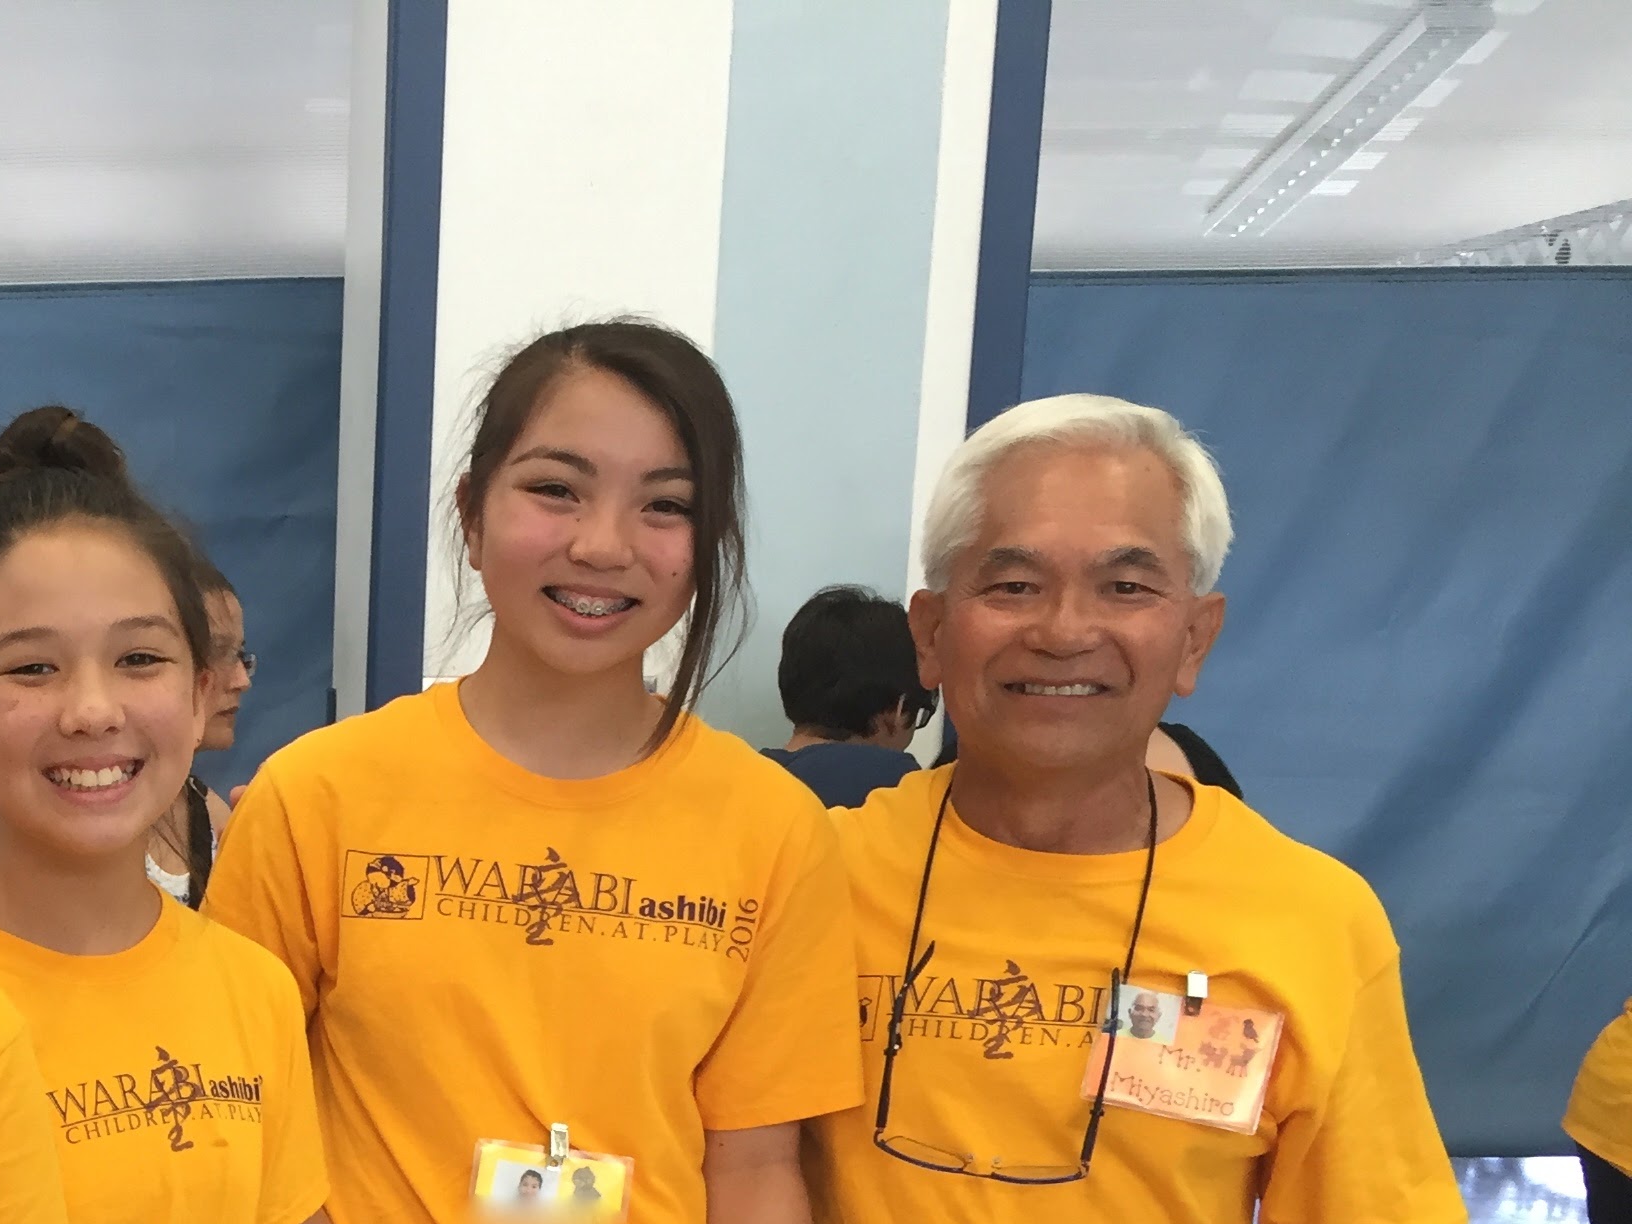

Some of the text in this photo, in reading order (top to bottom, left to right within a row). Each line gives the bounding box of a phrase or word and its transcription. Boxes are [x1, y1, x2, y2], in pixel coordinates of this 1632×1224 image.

[431, 856, 727, 928] WARABI ashibi
[726, 897, 758, 962] 2016
[885, 975, 1106, 1024] WARABI
[1158, 1045, 1201, 1072] Mr.
[45, 1063, 260, 1124] WARABI ashibi
[1110, 1071, 1235, 1117] Miyashiro
